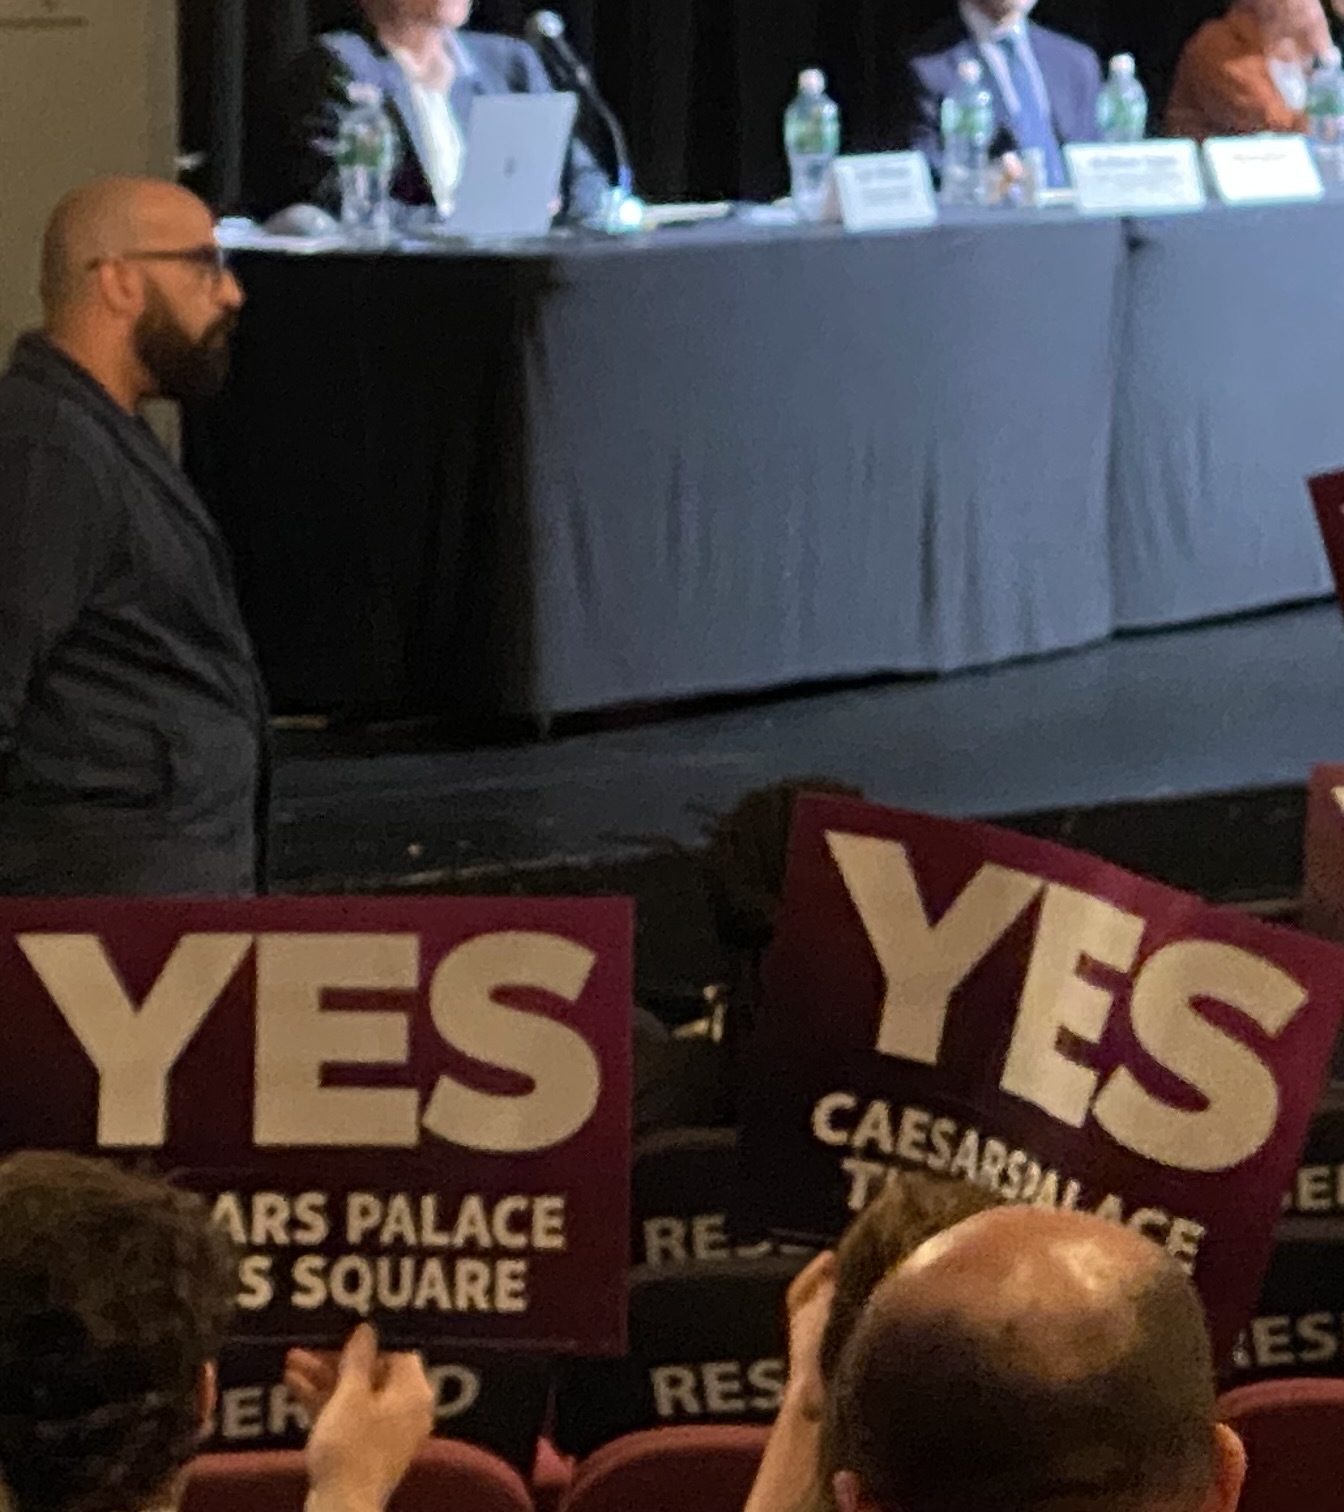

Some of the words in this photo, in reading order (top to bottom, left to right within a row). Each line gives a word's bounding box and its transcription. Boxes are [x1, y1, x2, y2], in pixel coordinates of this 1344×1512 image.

[14, 929, 601, 1153] YES
[824, 828, 1308, 1173] YES
[811, 1090, 1028, 1201] CAESARS
[346, 1191, 566, 1250] PALACE
[291, 1253, 528, 1317] SQUARE
